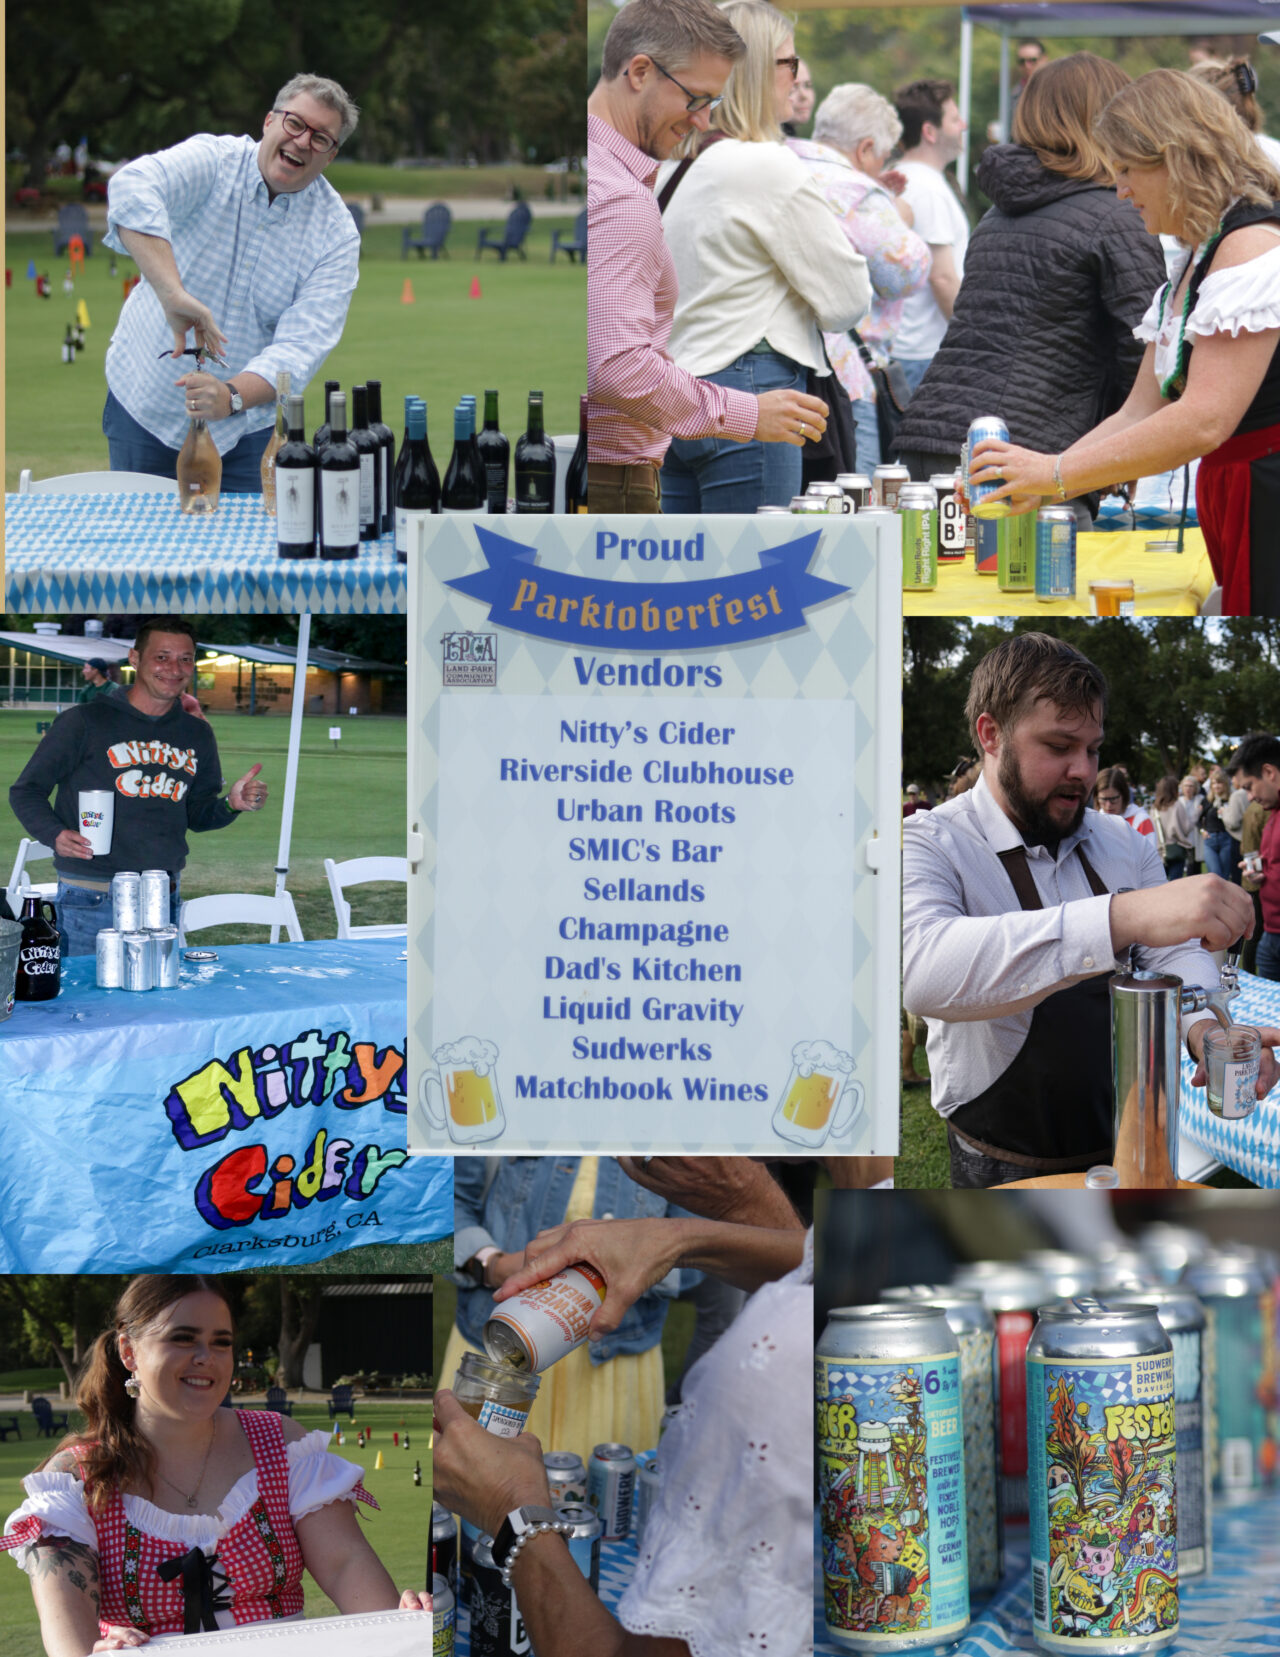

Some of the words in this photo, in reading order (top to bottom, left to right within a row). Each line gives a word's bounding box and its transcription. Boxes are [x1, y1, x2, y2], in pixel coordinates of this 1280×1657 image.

[921, 512, 931, 530] IPA
[596, 531, 704, 561] Proud
[510, 578, 783, 632] Parktoberfest
[446, 665, 469, 673] LAND
[471, 665, 494, 673] PARK
[573, 656, 723, 688] Vendors
[658, 720, 736, 745] Cider
[107, 740, 198, 776] Nitty's
[500, 758, 633, 783] Riverside
[643, 759, 795, 785] Clubhouse
[556, 798, 643, 824] Urban
[654, 799, 737, 824] Roots
[568, 838, 660, 863] SMIC's
[671, 838, 723, 863] Bar
[584, 877, 705, 903] Sellands
[558, 916, 730, 948] Champagne
[545, 956, 622, 981] Dad's
[632, 957, 742, 983] Kitchen
[543, 995, 631, 1024] Liquid
[642, 997, 745, 1028] Gravity
[572, 1035, 713, 1062] Sudwerks
[163, 1028, 407, 1151] Nitty
[515, 1075, 673, 1101] Matchbook
[683, 1077, 769, 1101] Wines
[193, 1220, 342, 1260] Clarksburg,
[345, 1210, 384, 1229] CA
[549, 1282, 594, 1315] WHEAT
[516, 1288, 590, 1345] HEFEWEIZE
[931, 1417, 958, 1438] BEER
[615, 1471, 633, 1535] SUDWERK
[940, 1514, 960, 1529] HOPS
